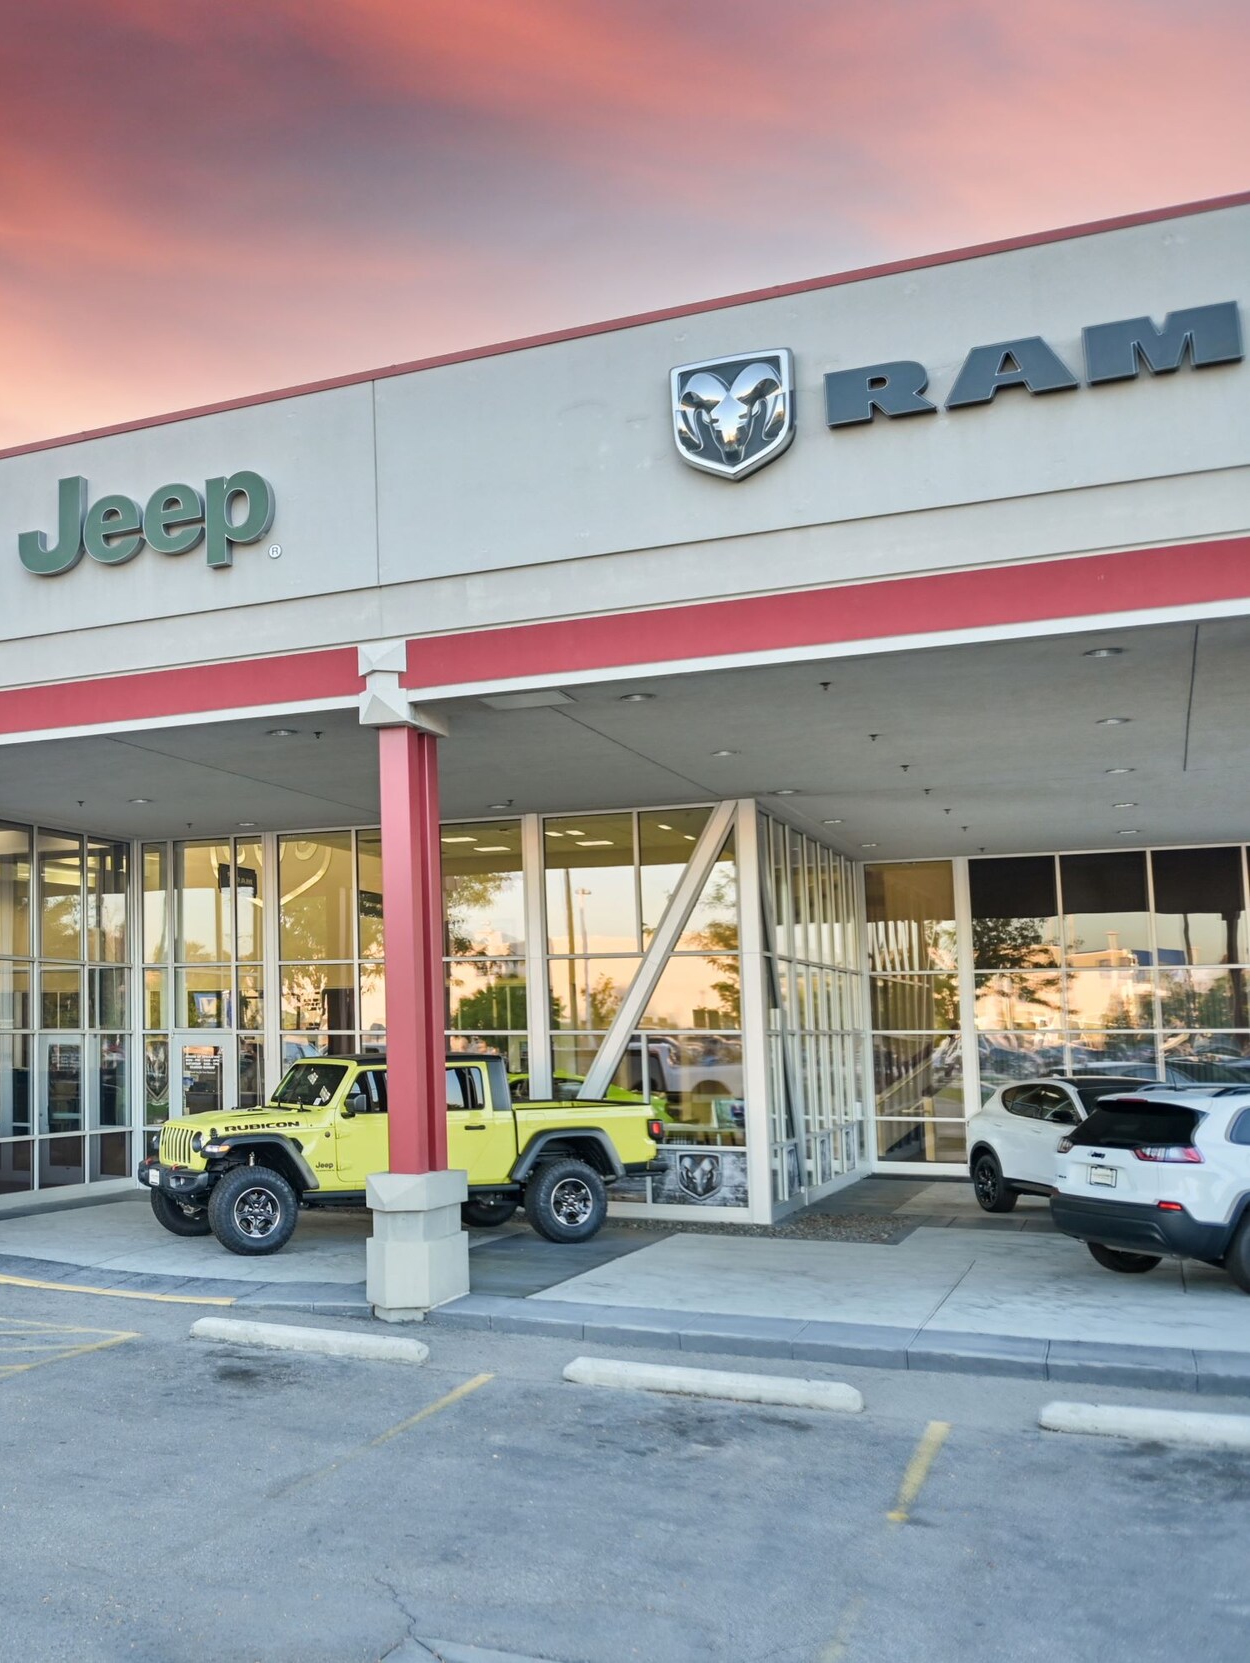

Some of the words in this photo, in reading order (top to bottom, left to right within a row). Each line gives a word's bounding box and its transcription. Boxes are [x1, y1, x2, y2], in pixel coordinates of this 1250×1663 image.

[823, 300, 1244, 430] RAM
[18, 470, 276, 576] Jeep
[224, 1121, 300, 1132] RUBICON
[315, 1161, 334, 1169] Jeep
